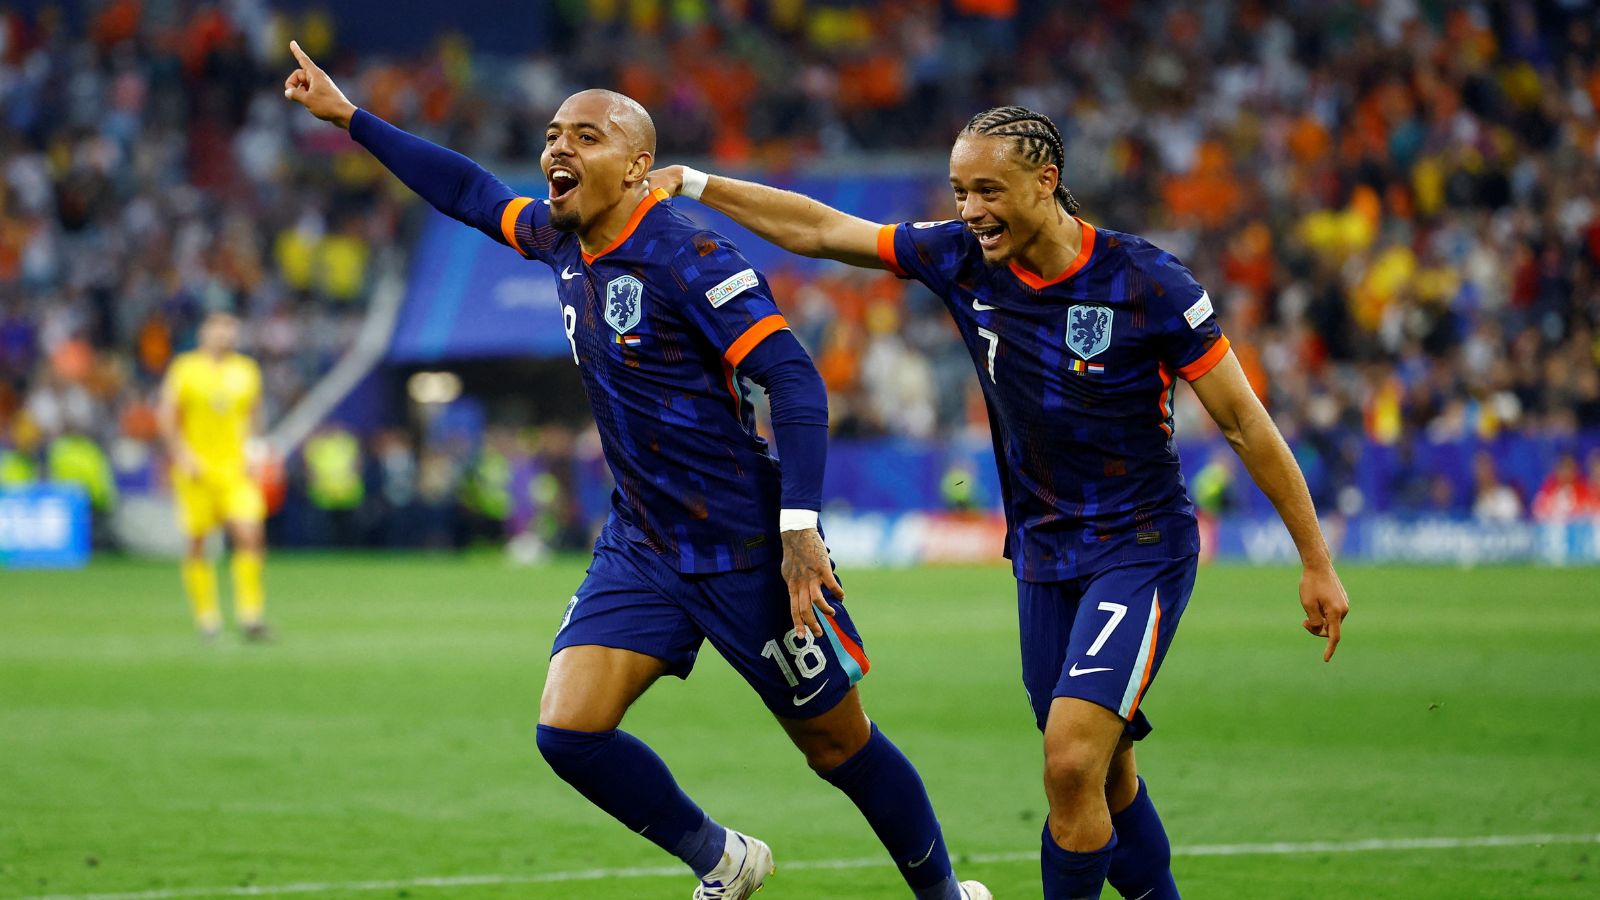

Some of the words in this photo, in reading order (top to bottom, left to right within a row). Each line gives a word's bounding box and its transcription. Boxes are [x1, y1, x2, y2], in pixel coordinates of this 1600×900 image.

[977, 326, 999, 385] 7
[760, 624, 827, 688] 18
[1085, 601, 1128, 657] 7
